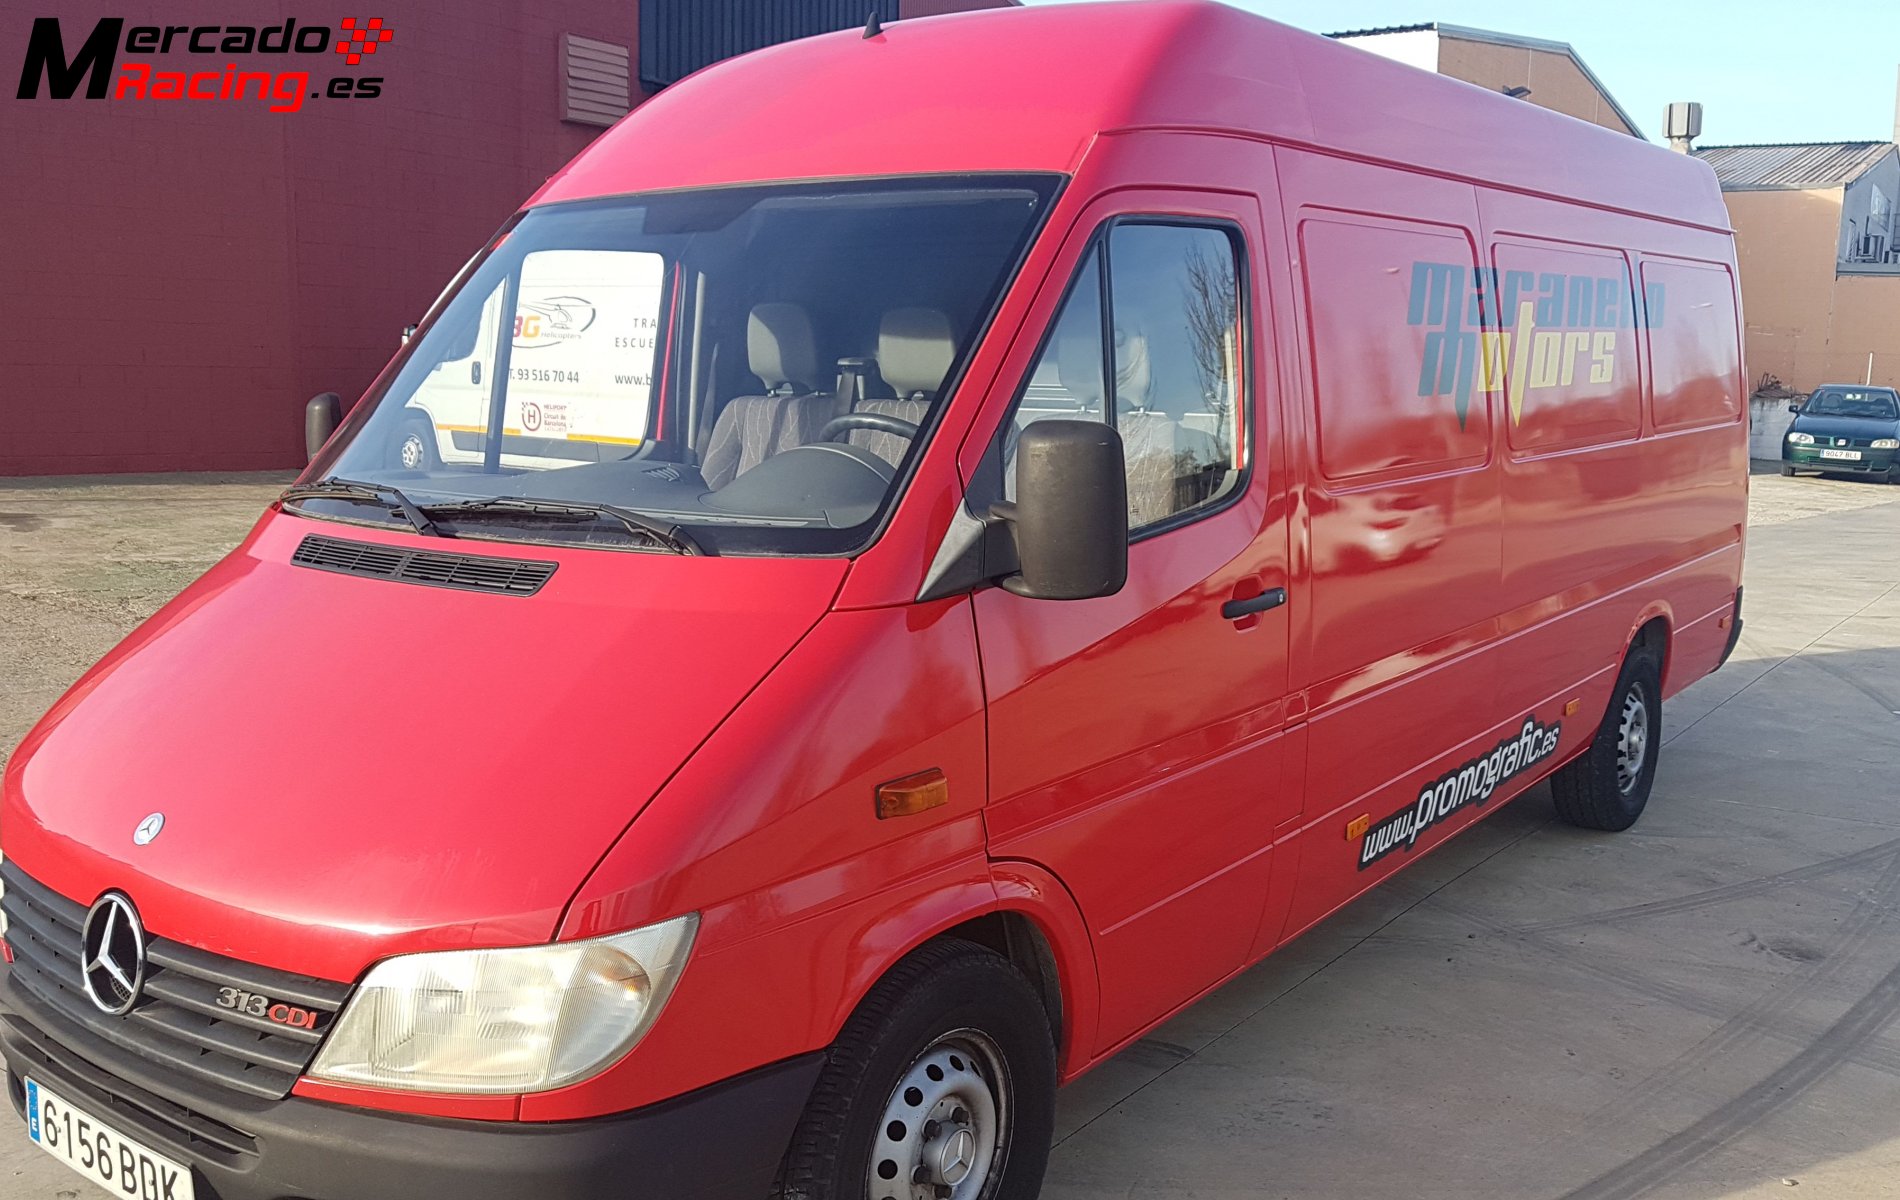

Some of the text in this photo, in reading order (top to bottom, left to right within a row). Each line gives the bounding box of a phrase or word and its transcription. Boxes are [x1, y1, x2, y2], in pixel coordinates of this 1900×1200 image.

[633, 318, 657, 329] TRA
[615, 337, 654, 349] ESCUE
[517, 368, 529, 380] 93
[532, 369, 550, 382] 516
[552, 370, 565, 382] 70
[567, 371, 579, 384] 44
[1362, 721, 1560, 863] www.promografic.es
[31, 1116, 38, 1132] E
[44, 1099, 178, 1200] 6156 BDK
